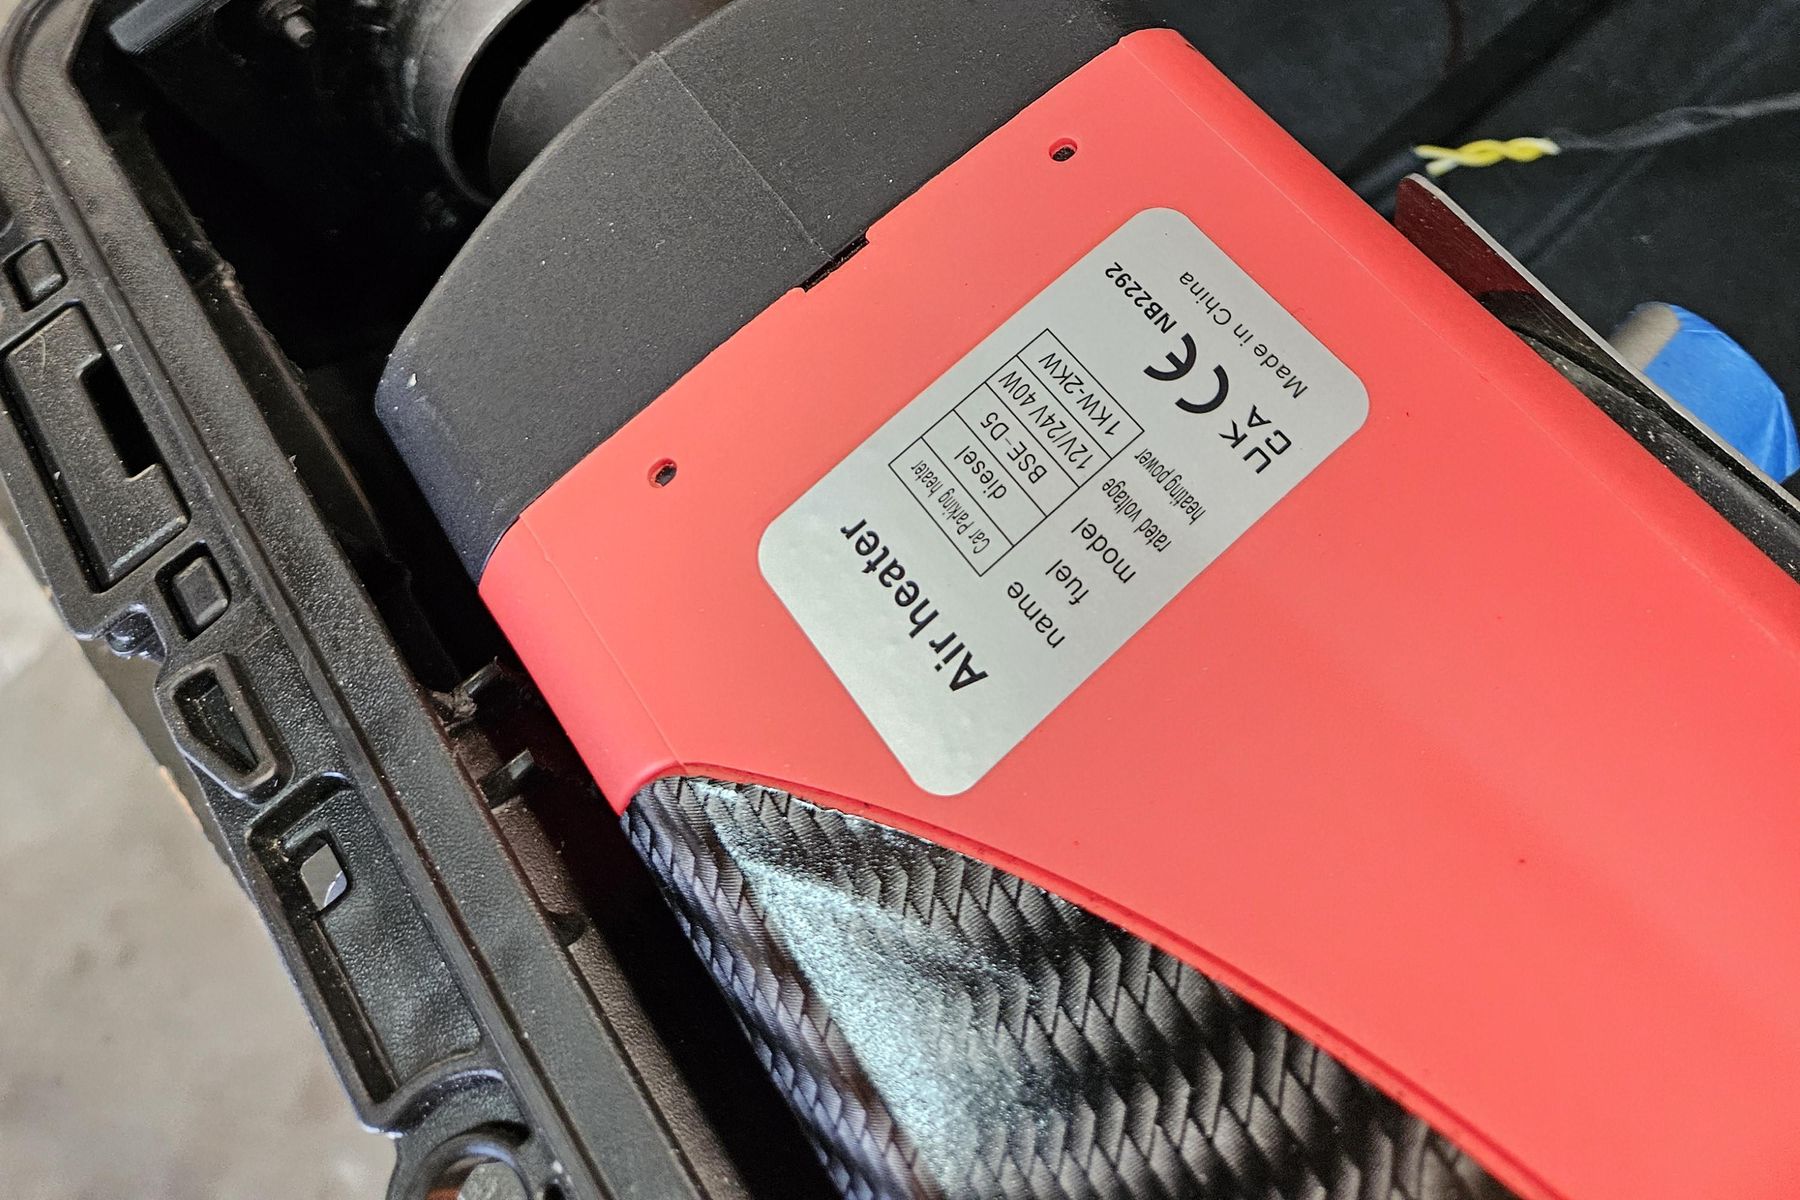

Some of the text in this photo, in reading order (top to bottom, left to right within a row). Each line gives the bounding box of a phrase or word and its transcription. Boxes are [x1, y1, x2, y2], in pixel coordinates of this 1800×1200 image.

[1104, 261, 1178, 335] NB2292
[1179, 271, 1309, 400] Made in China
[997, 370, 1094, 470] 12V/24V 40W
[1037, 352, 1121, 436] 1KW-2KW
[953, 444, 1008, 500] diesel
[979, 411, 1048, 485] BSE-D5
[910, 459, 991, 555] Car Parking heater
[1101, 477, 1172, 553] rated voltage
[1133, 447, 1207, 526] heating power
[1044, 558, 1090, 606] fuel
[1070, 516, 1137, 584] model
[839, 518, 990, 691] Air heater
[1006, 581, 1066, 649] name
